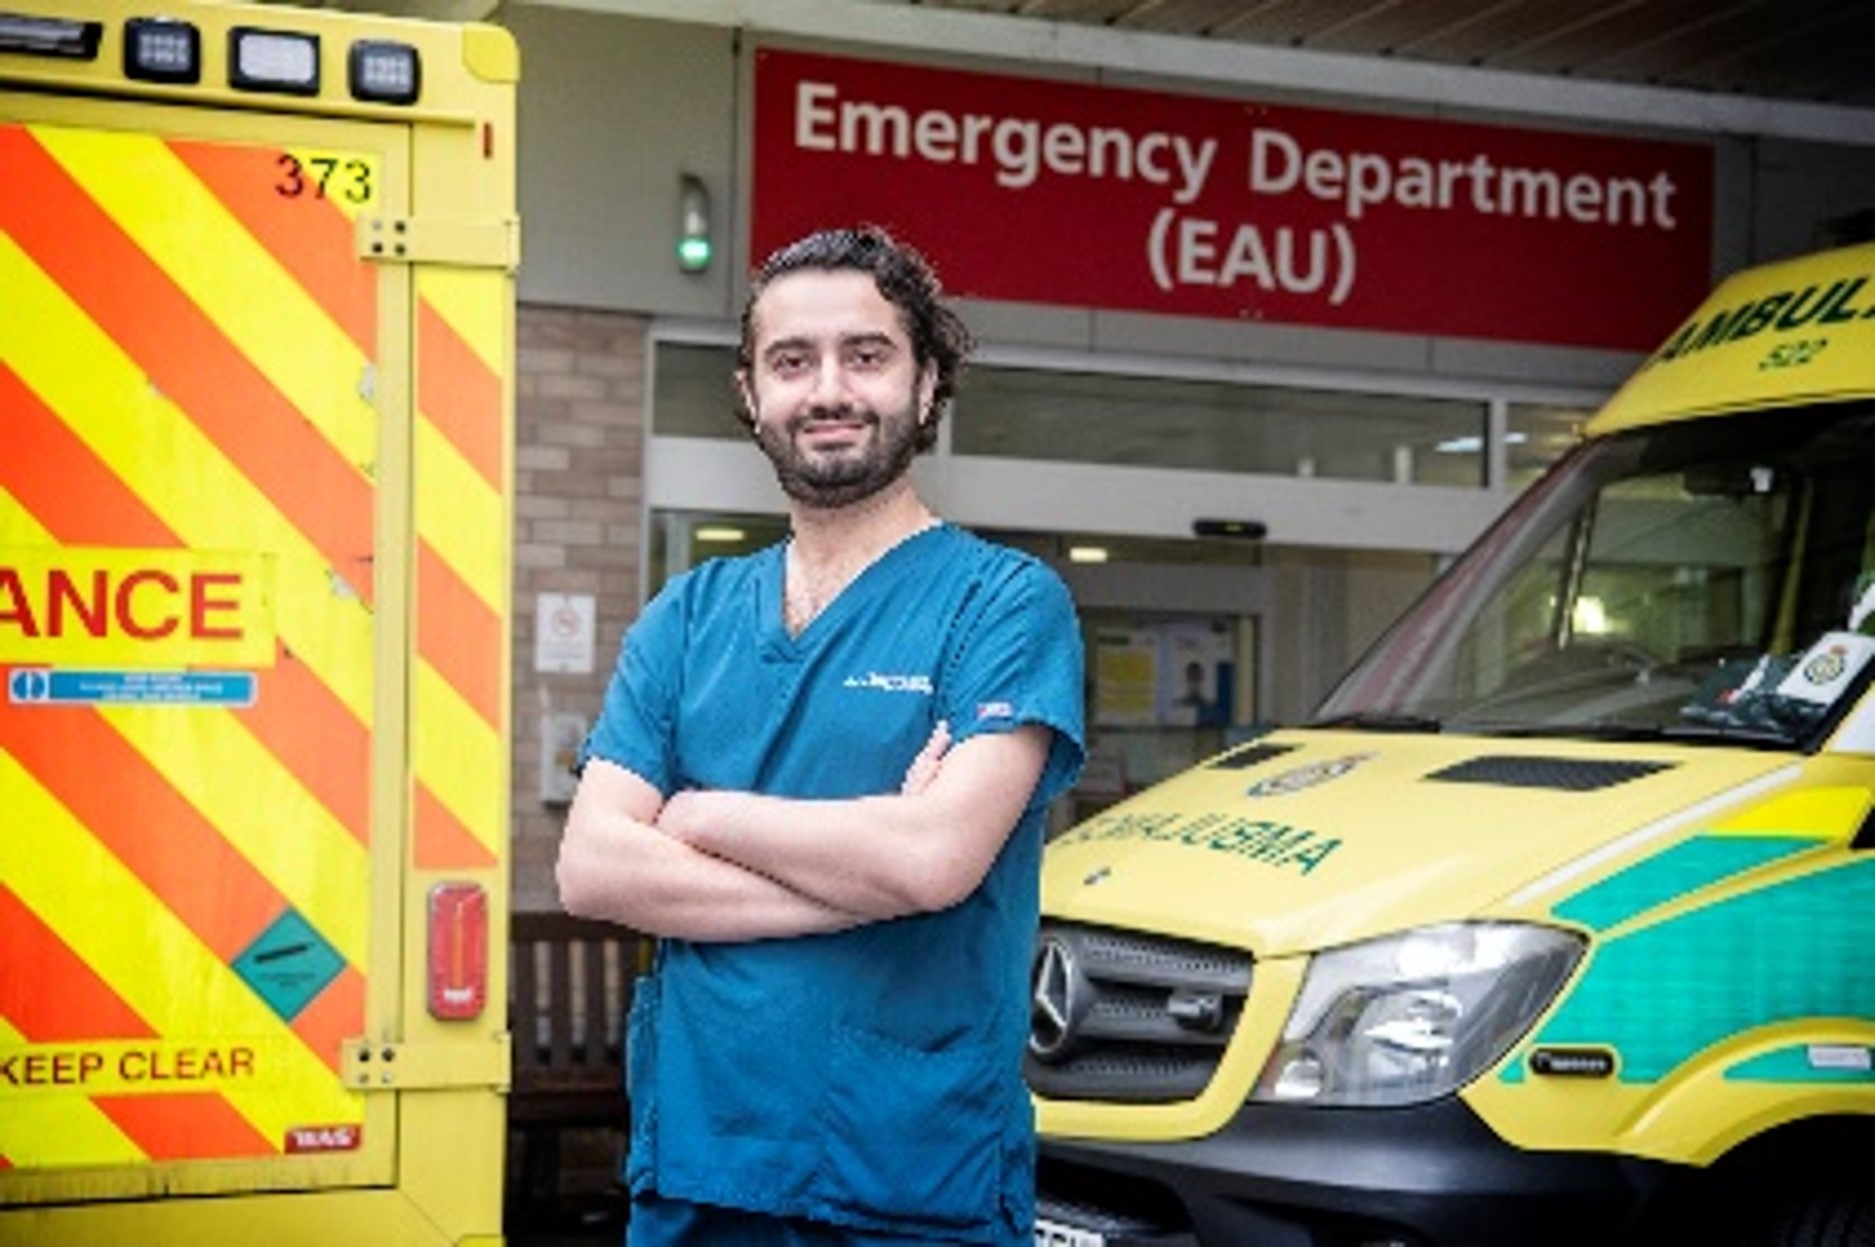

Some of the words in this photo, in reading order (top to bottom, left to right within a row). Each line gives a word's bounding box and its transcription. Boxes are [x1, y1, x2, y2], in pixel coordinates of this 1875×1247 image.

[275, 153, 371, 203] 373
[794, 81, 1217, 201] Emergency
[1249, 128, 1677, 230] Department
[1146, 207, 1357, 305] (EAU)
[1660, 274, 1875, 362] AMBUL
[0, 568, 243, 640] ANCE
[0, 1053, 104, 1085] KEEP
[119, 1047, 255, 1081] CLEAR
